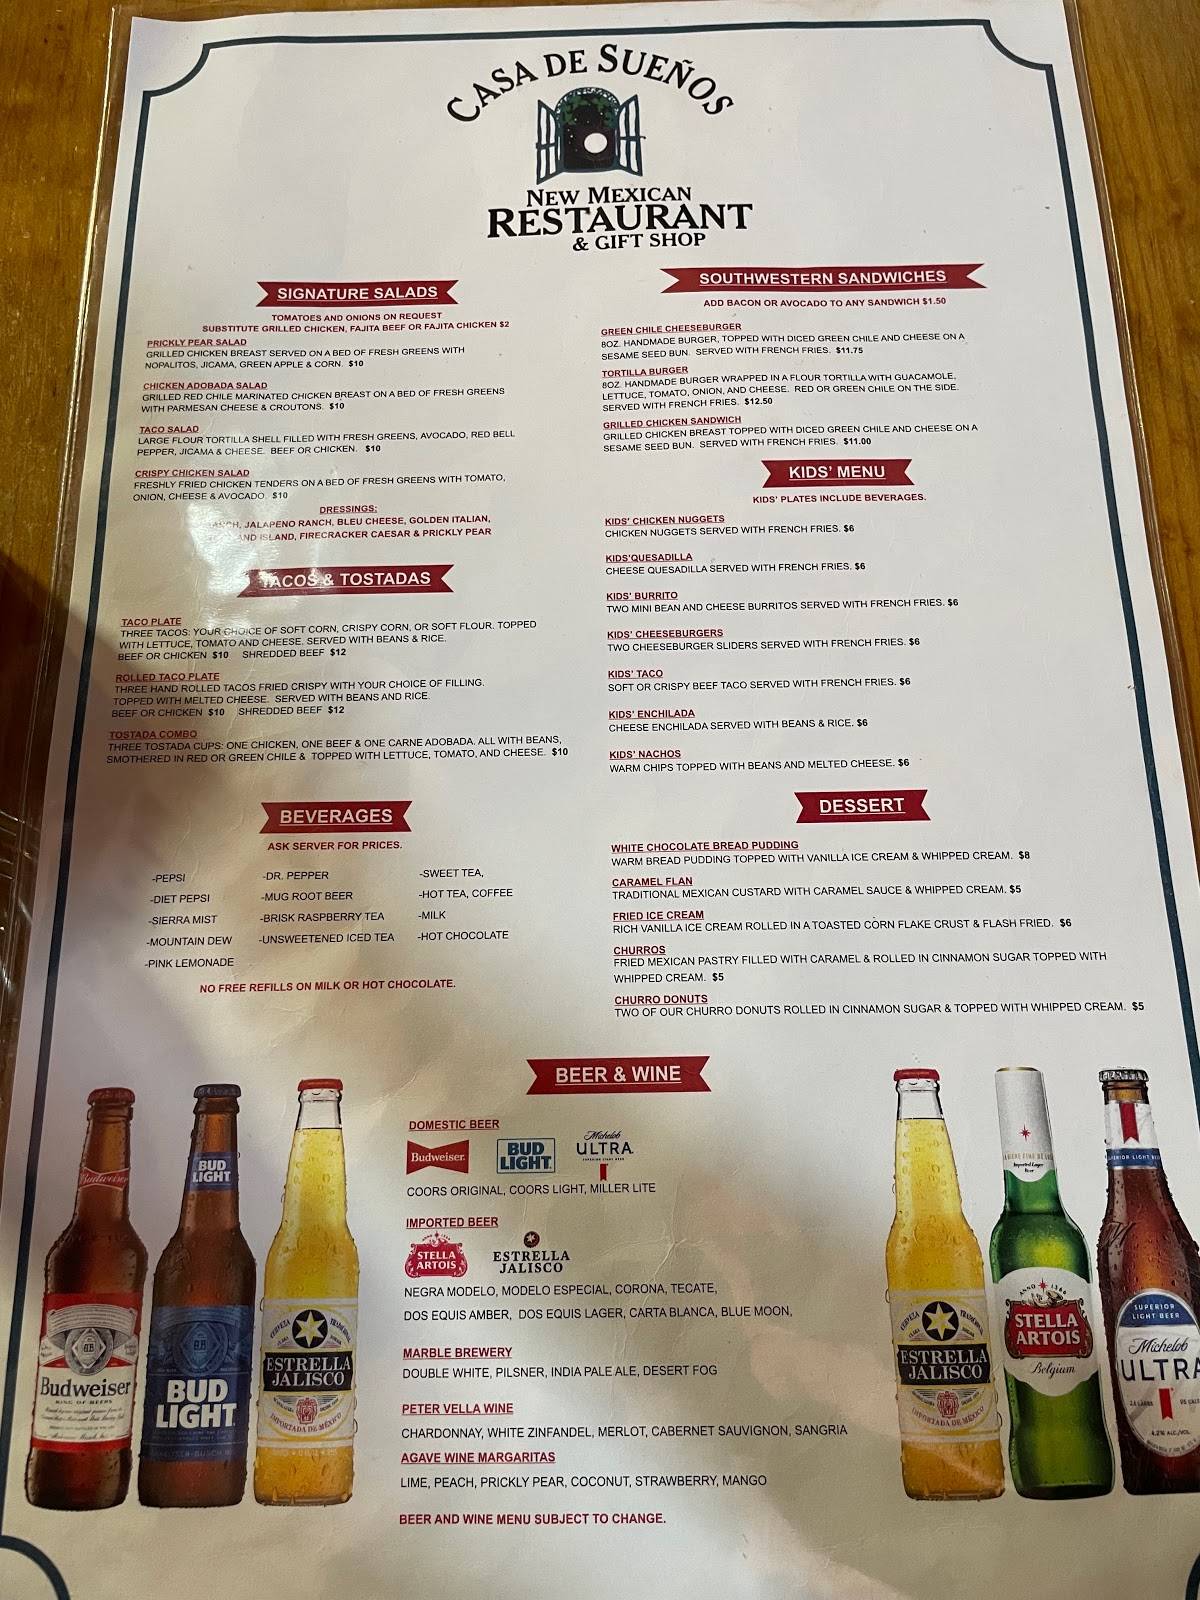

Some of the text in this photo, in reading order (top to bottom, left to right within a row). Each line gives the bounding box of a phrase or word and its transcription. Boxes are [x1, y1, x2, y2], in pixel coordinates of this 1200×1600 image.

[446, 44, 734, 122] CASA DE SUEÑOS
[526, 186, 691, 207] NEW MEXICAN
[488, 204, 752, 238] RESTAURANT
[572, 232, 706, 251] & GIFT SHOP
[699, 270, 947, 285] SOUTHWESTERN SANDWICHES
[277, 284, 438, 300] SIGNATURE SALADS
[703, 297, 947, 308] ADD BACON OR AVOCADO TO ANY SANDWICH $1.50
[600, 322, 742, 336] GREEN CHILE CHEESEBURGER
[147, 337, 248, 347] PRICKLY PEAR SALAD
[144, 359, 364, 371] NOPALITOS, JICAMA, GREEN APPLE & CORN. $10
[601, 366, 689, 378] TORTILLA BURGER
[139, 424, 200, 434] TACO SALAD
[837, 465, 885, 478] MENU
[780, 495, 818, 503] PLATES
[819, 494, 862, 503] INCLUDE
[864, 494, 927, 502] BEVERAGES.
[319, 504, 378, 514] DRESSINGS:
[244, 520, 296, 529] JALAPENO
[298, 519, 335, 529] RANCH,
[336, 518, 363, 527] BLEU
[365, 517, 407, 528] CHEESE,
[408, 516, 450, 525] GOLDEN
[451, 515, 491, 526] ITALIAN,
[632, 516, 676, 525] CHICKEN
[678, 515, 725, 524] NUGGETS
[320, 573, 335, 586] &
[339, 572, 431, 586] TOSTADAS
[121, 617, 182, 626] TACO PLATE
[117, 648, 347, 661] BEEF OR CHICKEN $10 SHREDDED BEEF $12
[636, 668, 664, 678] TACO
[819, 798, 905, 814] DESSERT
[280, 808, 393, 825] BEVERAGES
[610, 840, 799, 853] WHITE CHOCOLATE BREAD PUDDING
[151, 873, 186, 883] -PEPSI
[262, 871, 329, 880] -DR. PEPPER
[149, 893, 211, 904] -DIET PEPSI
[418, 887, 514, 900] -HOT TEA, COFFEE
[417, 910, 446, 920] -MILK
[417, 930, 509, 941] -HOT CHOCOLATE
[613, 945, 666, 955] CHURROS
[613, 972, 725, 983] WHIPPED CREAM. $5
[199, 978, 456, 994] NO FREE REFILLS ON MILK OR HOT CHOCOLATE.
[556, 1066, 681, 1083] BEER & WINE
[409, 1118, 500, 1130] DOMESTIC BEER
[584, 1130, 621, 1140] Michelob
[508, 1142, 544, 1155] BUD
[576, 1142, 632, 1155] ULTRA
[198, 1160, 226, 1171] BUD
[500, 1156, 552, 1170] LIGHT
[193, 1171, 230, 1183] LIGHT
[406, 1183, 656, 1198] COORS ORIGINAL, COORS LIGHT, MILLER LITE
[406, 1216, 499, 1228] IMPORTED BEER
[417, 1251, 456, 1260] STELLA
[493, 1250, 570, 1262] ESTRELLA
[416, 1260, 456, 1270] ARTOIS
[500, 1262, 563, 1274] JALISCO
[1015, 1313, 1079, 1328] STELLA
[1016, 1330, 1081, 1346] ARTOIS
[1129, 1337, 1189, 1354] Michelob
[403, 1346, 513, 1359] MARBLE BREWERY
[901, 1349, 988, 1365] ESTRELLA
[267, 1356, 350, 1372] ESTRELLA
[1032, 1361, 1076, 1379] Belgium
[908, 1364, 983, 1380] JALISCO
[272, 1371, 345, 1387] JALISCO
[40, 1376, 131, 1397] Budweiser
[167, 1379, 229, 1403] BUD
[156, 1403, 237, 1429] LIGHT
[400, 1475, 768, 1490] LIME, PEACH, PRICKLY PEAR, COCONUT, STRAWBERRY, MANGO
